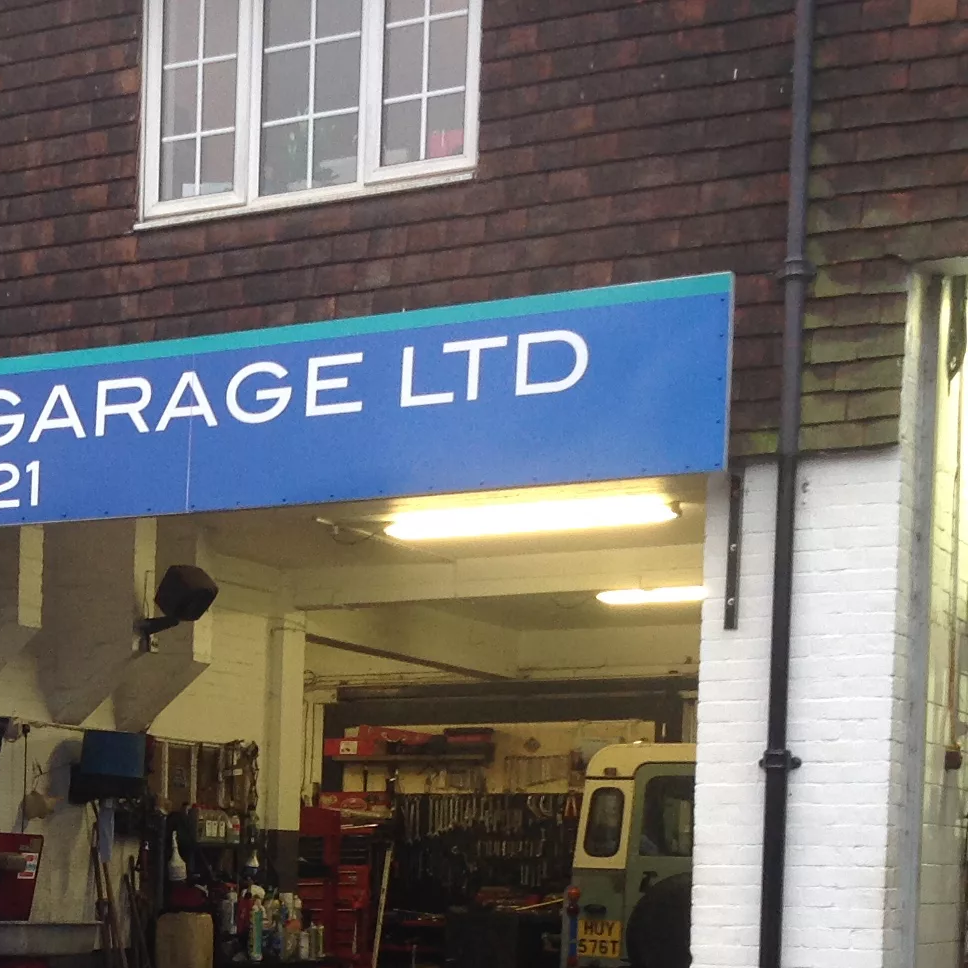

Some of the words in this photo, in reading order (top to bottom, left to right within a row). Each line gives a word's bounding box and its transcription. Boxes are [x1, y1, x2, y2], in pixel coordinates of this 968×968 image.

[400, 329, 590, 407] LTD
[584, 920, 615, 936] HUY
[579, 938, 620, 955] 576T
